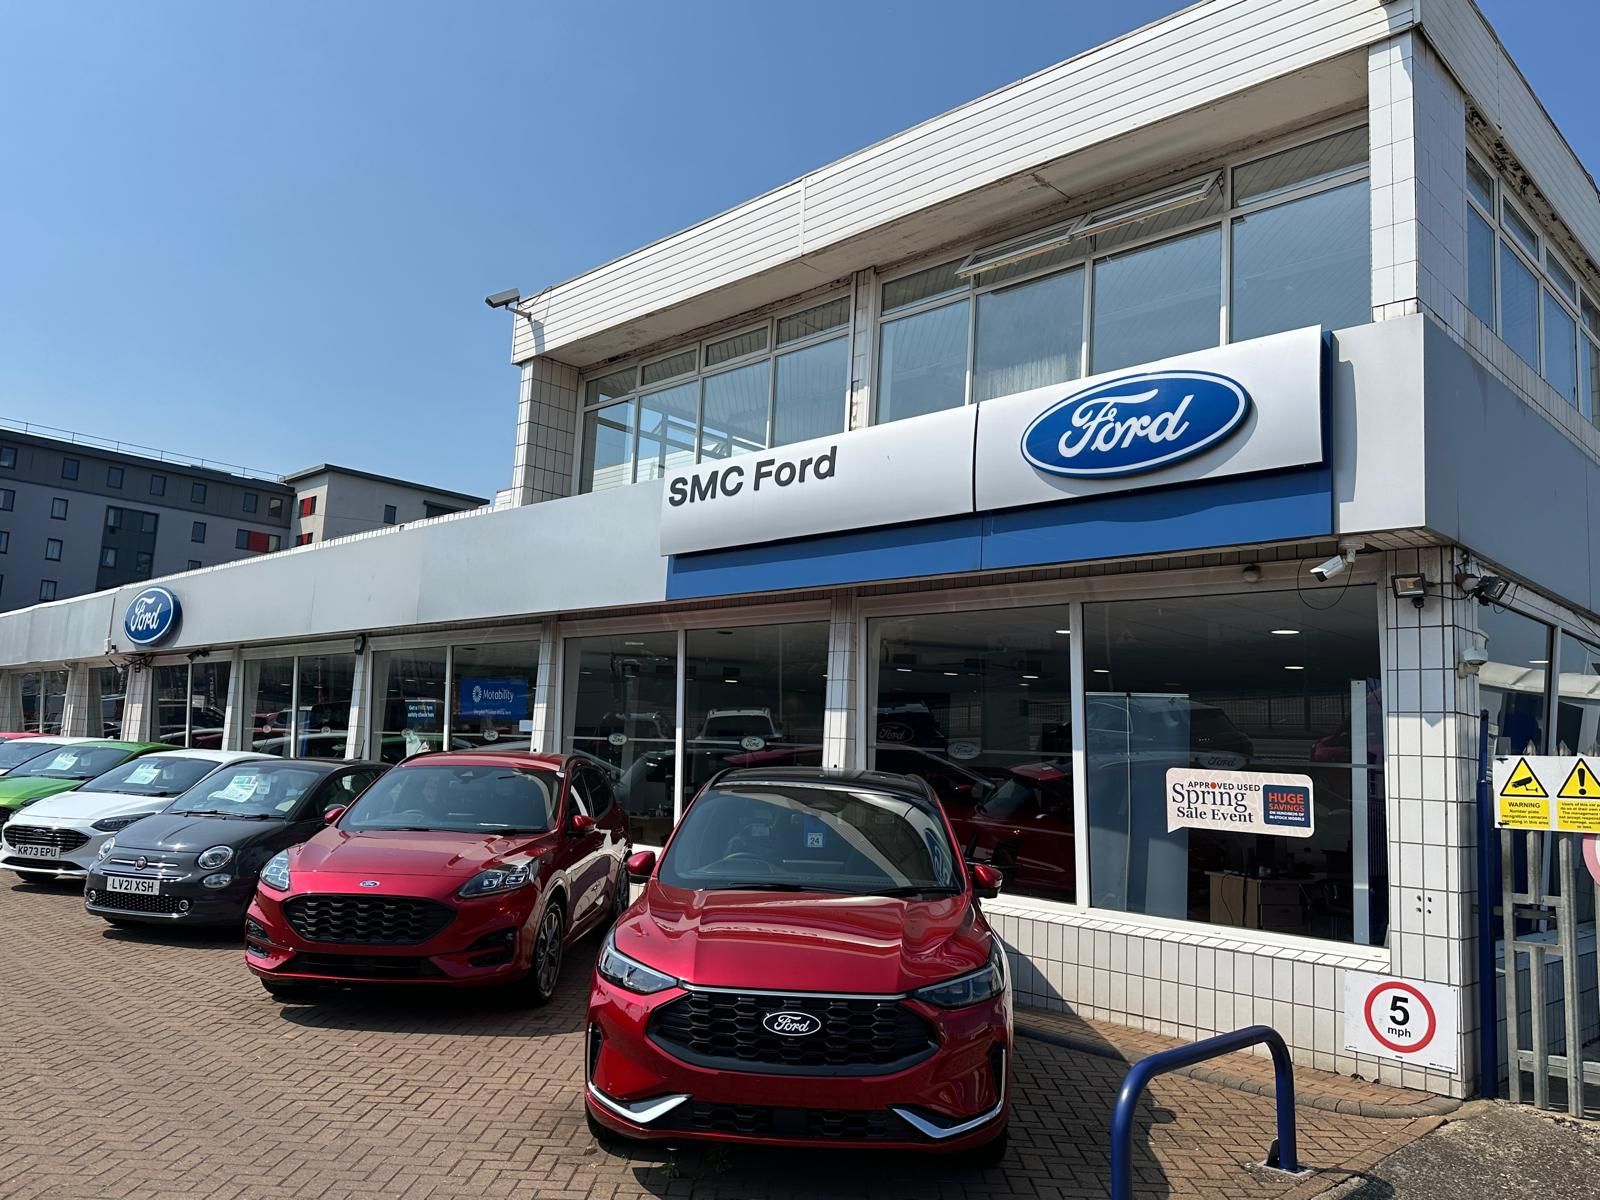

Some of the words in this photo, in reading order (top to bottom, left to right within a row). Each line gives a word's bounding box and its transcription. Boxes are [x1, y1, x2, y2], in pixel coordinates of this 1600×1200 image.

[1058, 389, 1195, 458] Ford
[669, 465, 745, 507] SMC
[753, 445, 838, 491] Ford
[130, 596, 163, 632] Ford
[482, 688, 514, 703] Motability
[1187, 780, 1235, 790] APPROVED
[1236, 783, 1261, 792] USED
[1172, 783, 1248, 813] Spring
[1268, 792, 1305, 804] HUGE
[1176, 806, 1208, 820] Sale
[1211, 809, 1254, 823] Event
[1268, 803, 1305, 812] SAVINGS
[17, 846, 39, 856] KR73
[40, 847, 57, 858] EPU
[111, 878, 133, 891] LV21
[134, 881, 154, 893] XSH
[1389, 995, 1410, 1026] 5
[773, 1014, 810, 1032] Ford
[1387, 1026, 1411, 1038] mph
